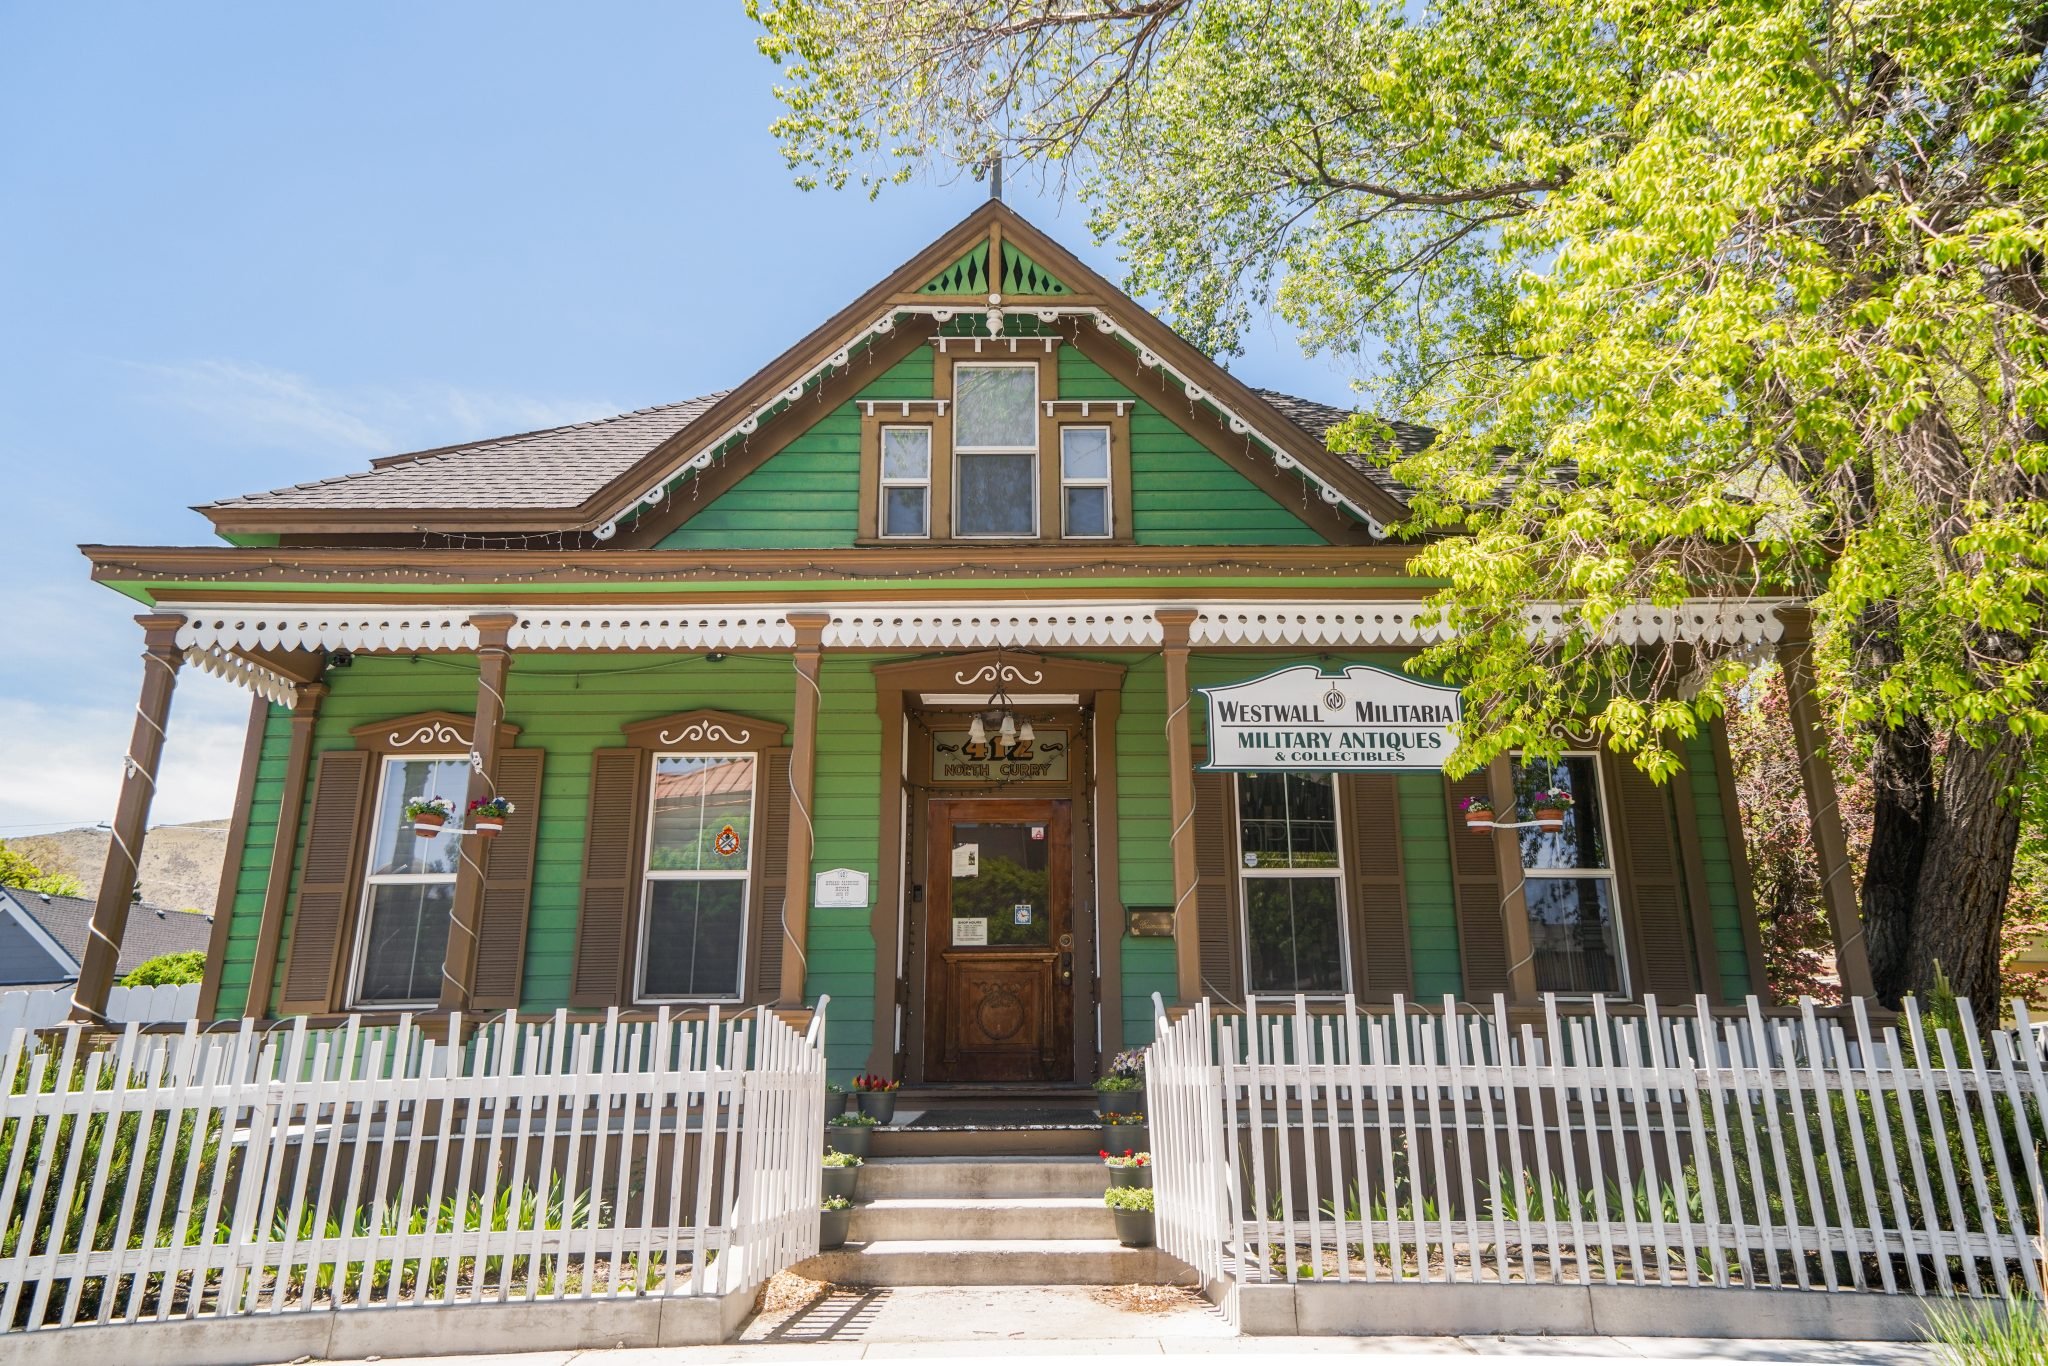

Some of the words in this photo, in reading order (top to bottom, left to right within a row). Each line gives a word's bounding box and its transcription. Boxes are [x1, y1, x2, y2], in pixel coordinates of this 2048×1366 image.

[1217, 701, 1325, 723] WESTWALL
[1355, 701, 1454, 723] MILITARIA
[961, 735, 1034, 761] 412
[1238, 732, 1333, 749] MILITARY
[1339, 732, 1441, 750] ANTIQUES
[1274, 752, 1286, 762] &
[1290, 751, 1406, 762] COLLECTIBLES
[944, 764, 990, 777] NORTH
[999, 763, 1052, 777] CURRY
